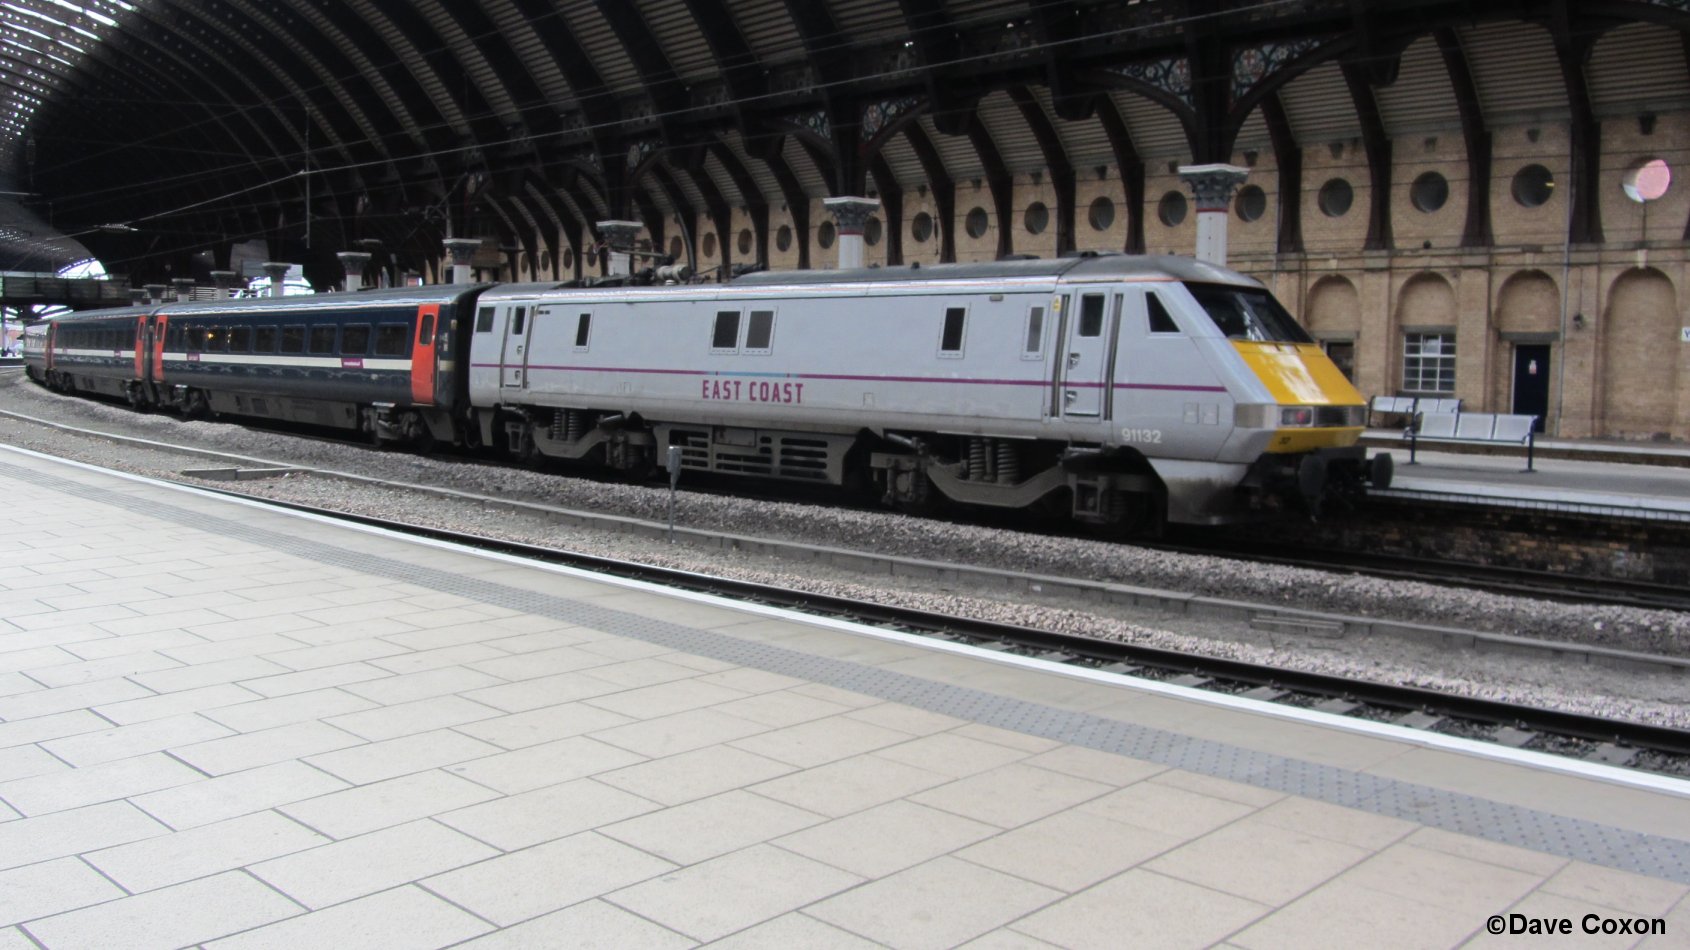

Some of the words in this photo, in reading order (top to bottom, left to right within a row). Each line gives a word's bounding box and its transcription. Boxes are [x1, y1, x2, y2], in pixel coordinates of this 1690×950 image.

[702, 380, 741, 400] EAST
[749, 381, 803, 403] COAST
[1121, 428, 1162, 443] 91132
